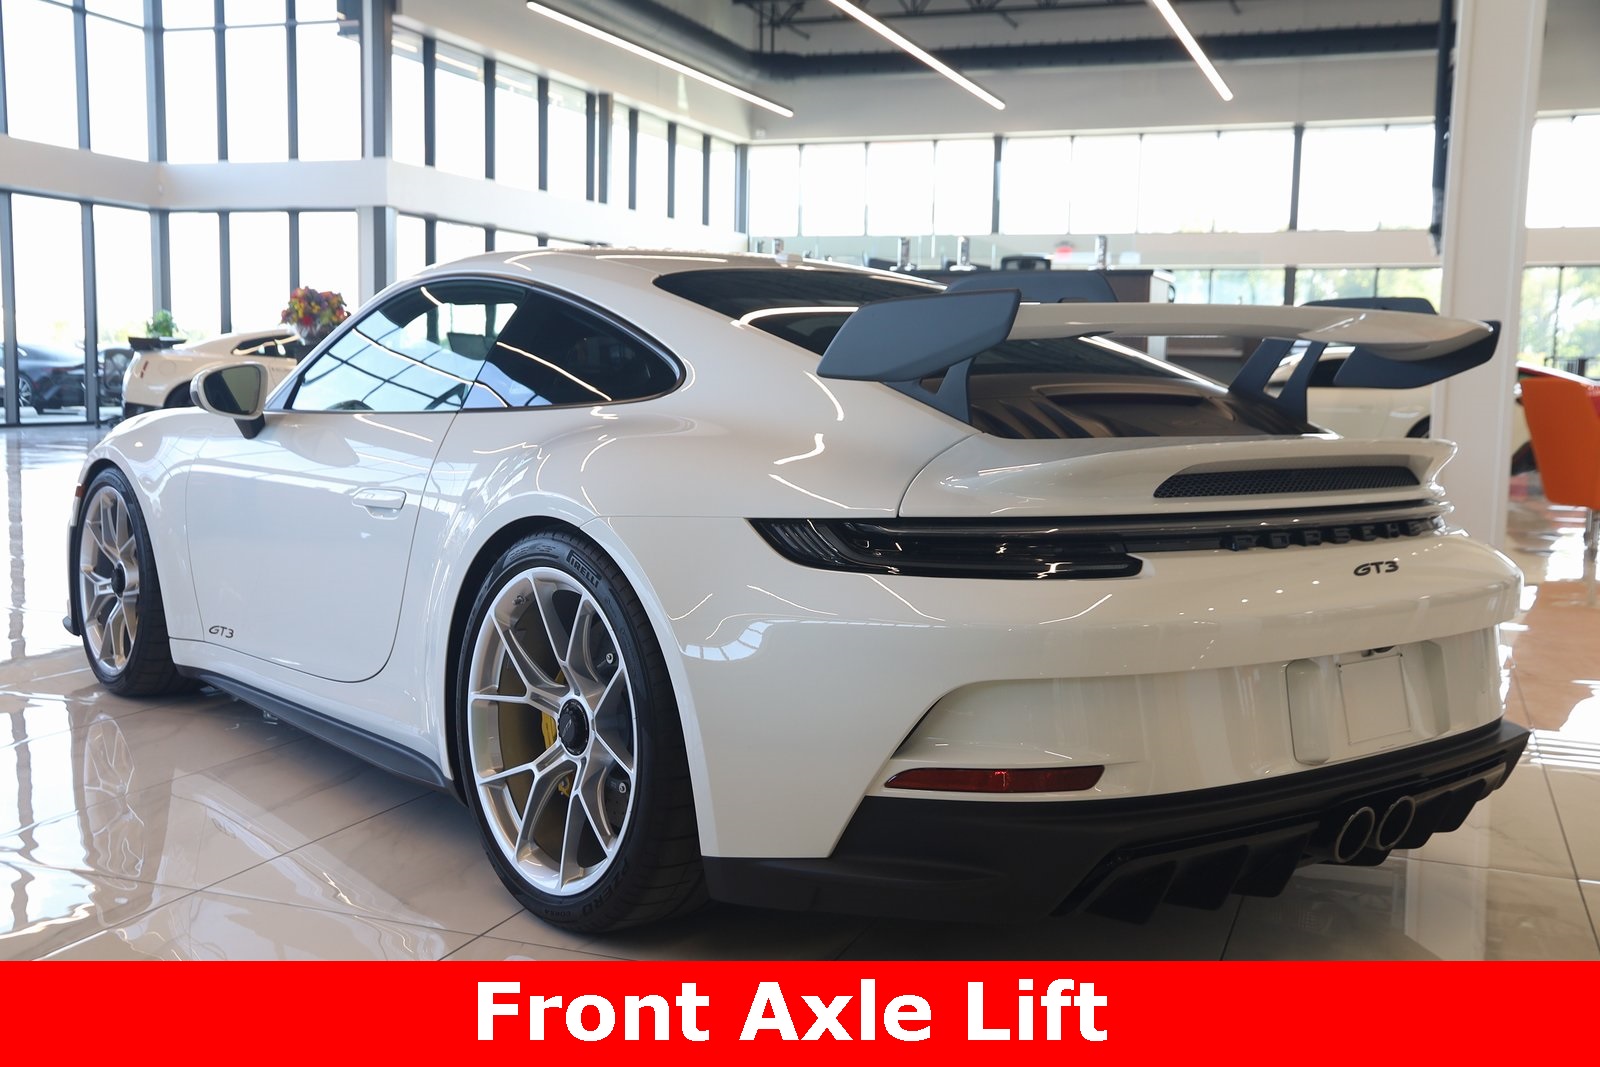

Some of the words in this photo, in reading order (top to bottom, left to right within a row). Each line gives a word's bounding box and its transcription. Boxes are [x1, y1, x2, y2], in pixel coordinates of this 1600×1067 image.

[1230, 516, 1429, 550] PORSCHE
[566, 549, 602, 588] PIRELLI
[1353, 560, 1400, 577] GT3
[208, 625, 234, 639] GT3
